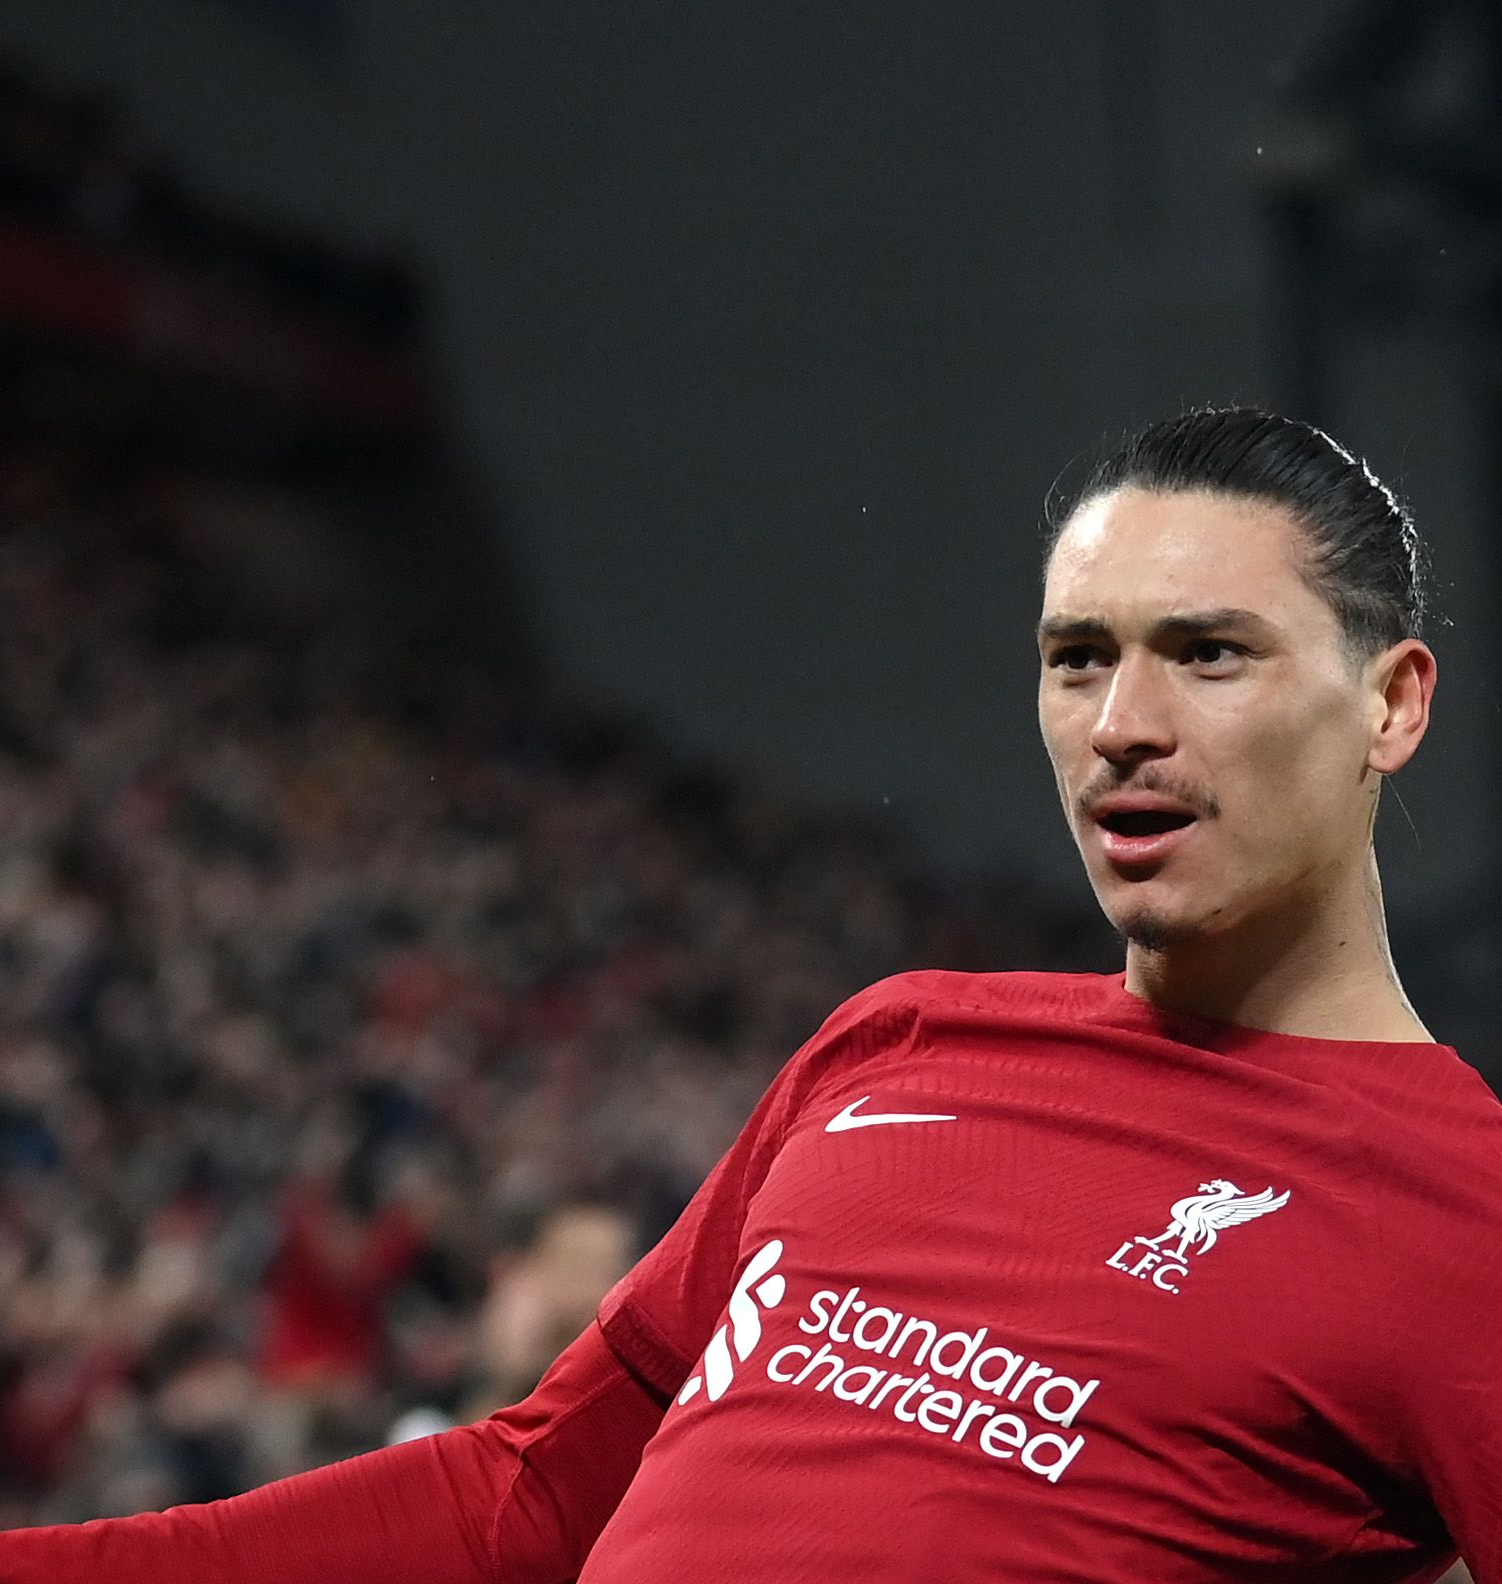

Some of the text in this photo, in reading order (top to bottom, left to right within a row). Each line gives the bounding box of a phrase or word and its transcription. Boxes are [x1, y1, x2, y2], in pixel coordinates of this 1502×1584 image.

[1104, 1241, 1190, 1295] L.F.C.
[766, 1342, 1086, 1483] chartered
[799, 1286, 1101, 1429] standard
